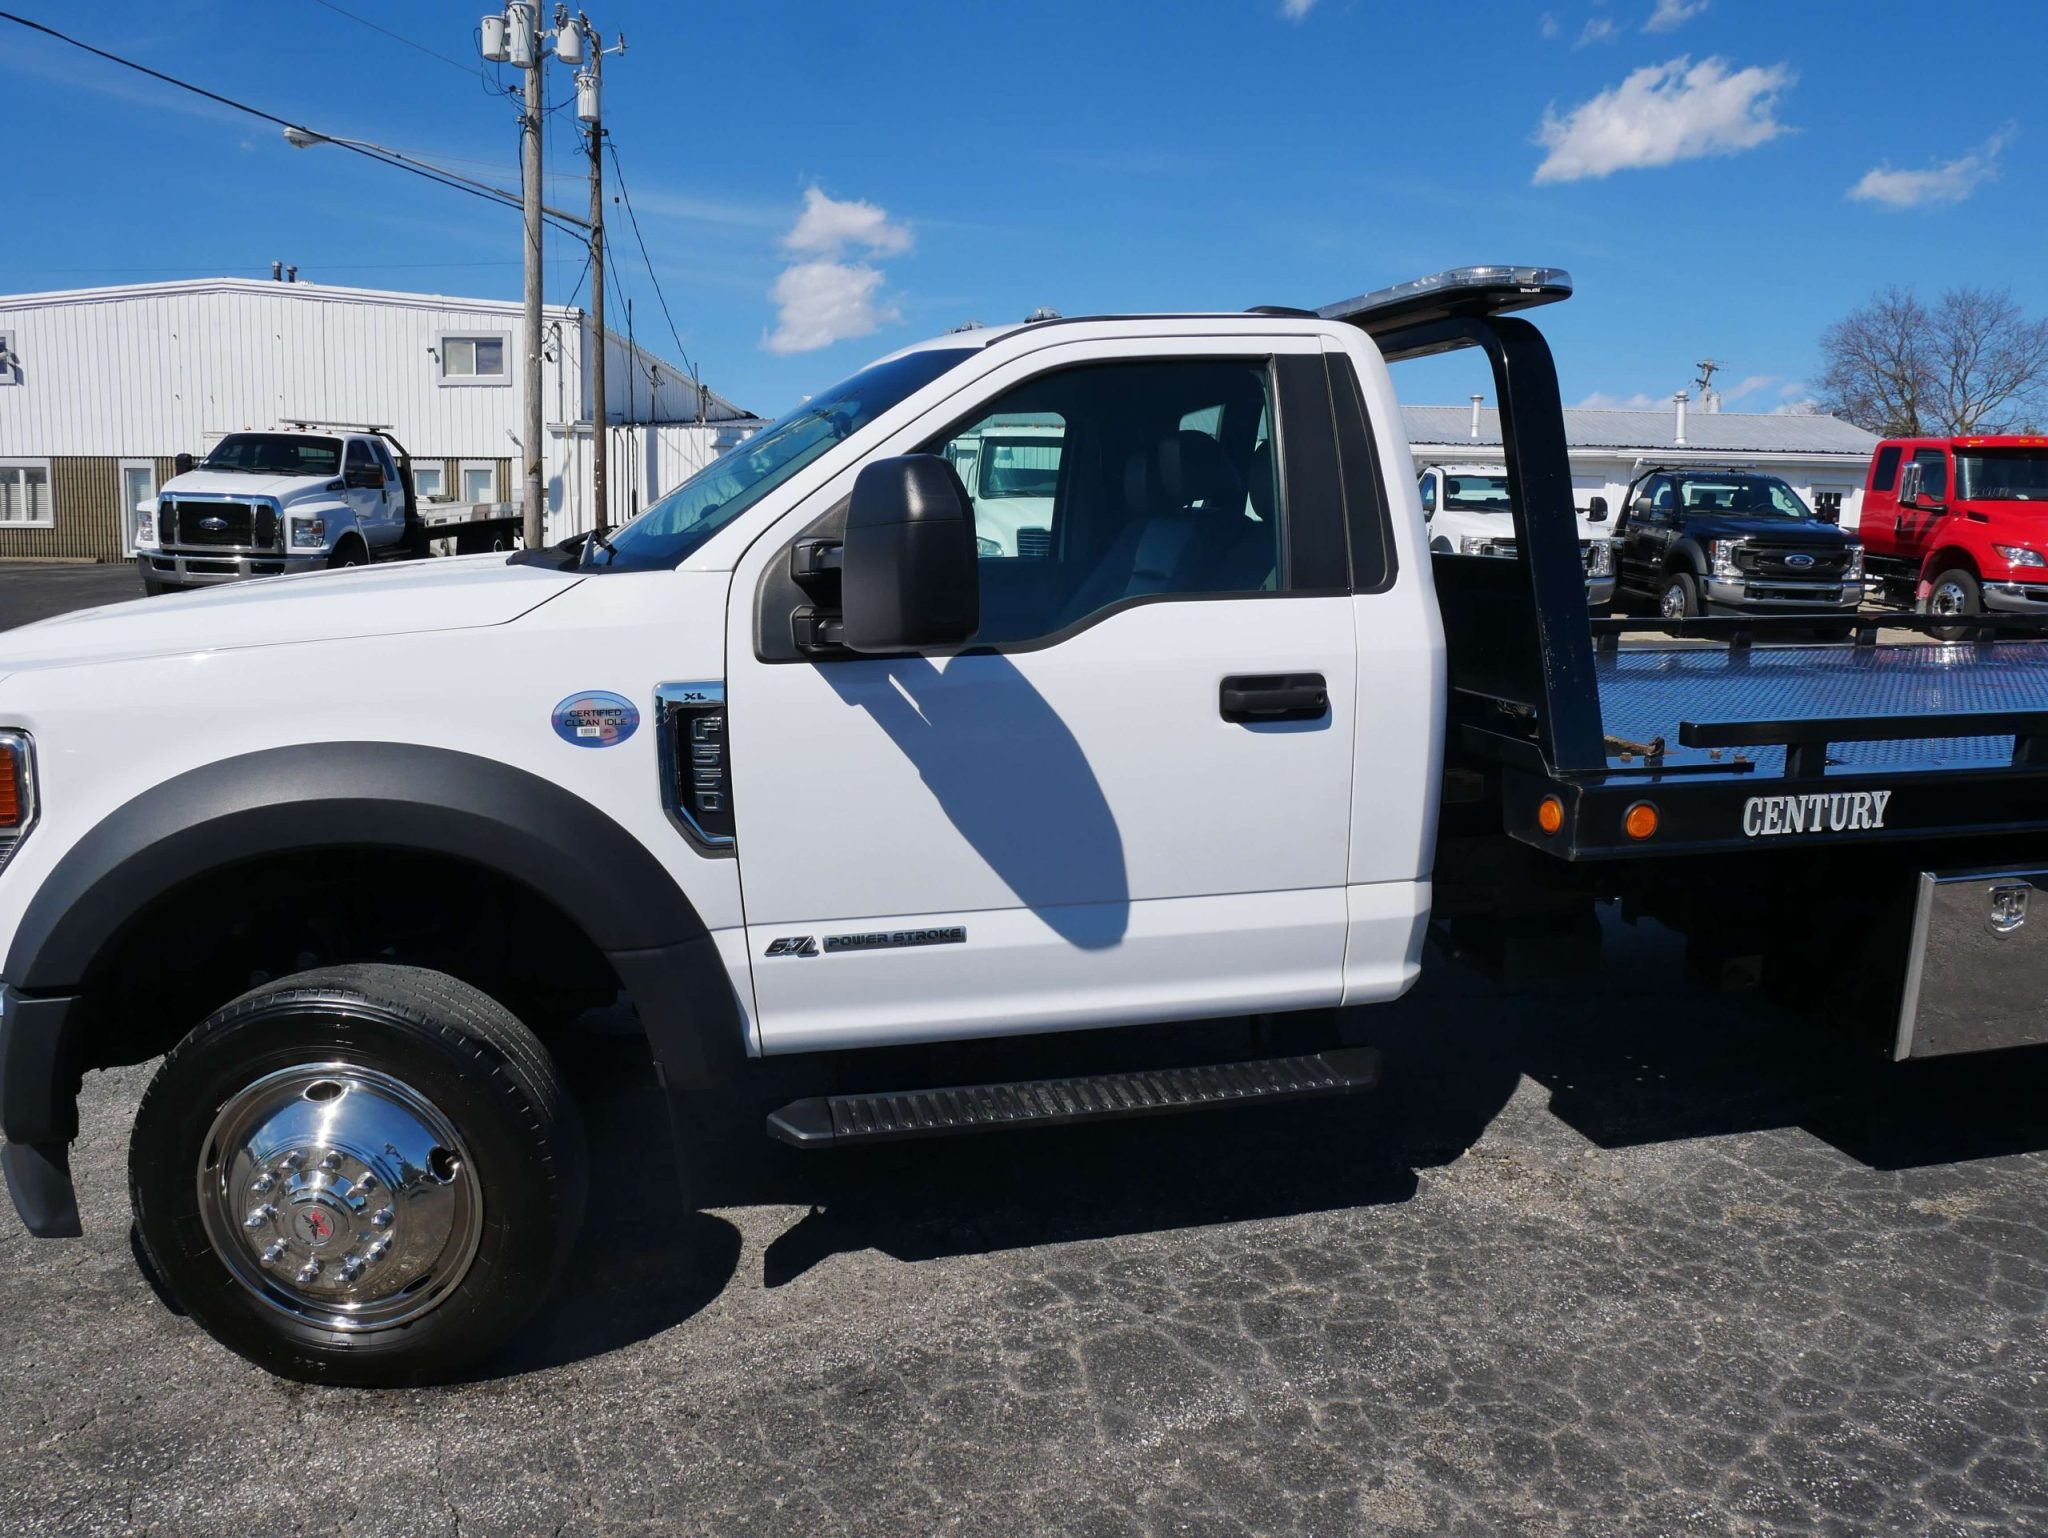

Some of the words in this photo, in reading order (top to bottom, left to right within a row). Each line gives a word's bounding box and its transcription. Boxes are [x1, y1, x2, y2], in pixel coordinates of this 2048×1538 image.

[684, 692, 706, 701] XL
[569, 709, 622, 718] CERTIFIED
[564, 719, 600, 727] CLEAN
[604, 718, 627, 726] IDLE
[1743, 790, 1892, 836] CENTURY
[828, 934, 889, 947] POWER
[892, 928, 961, 943] STROKE
